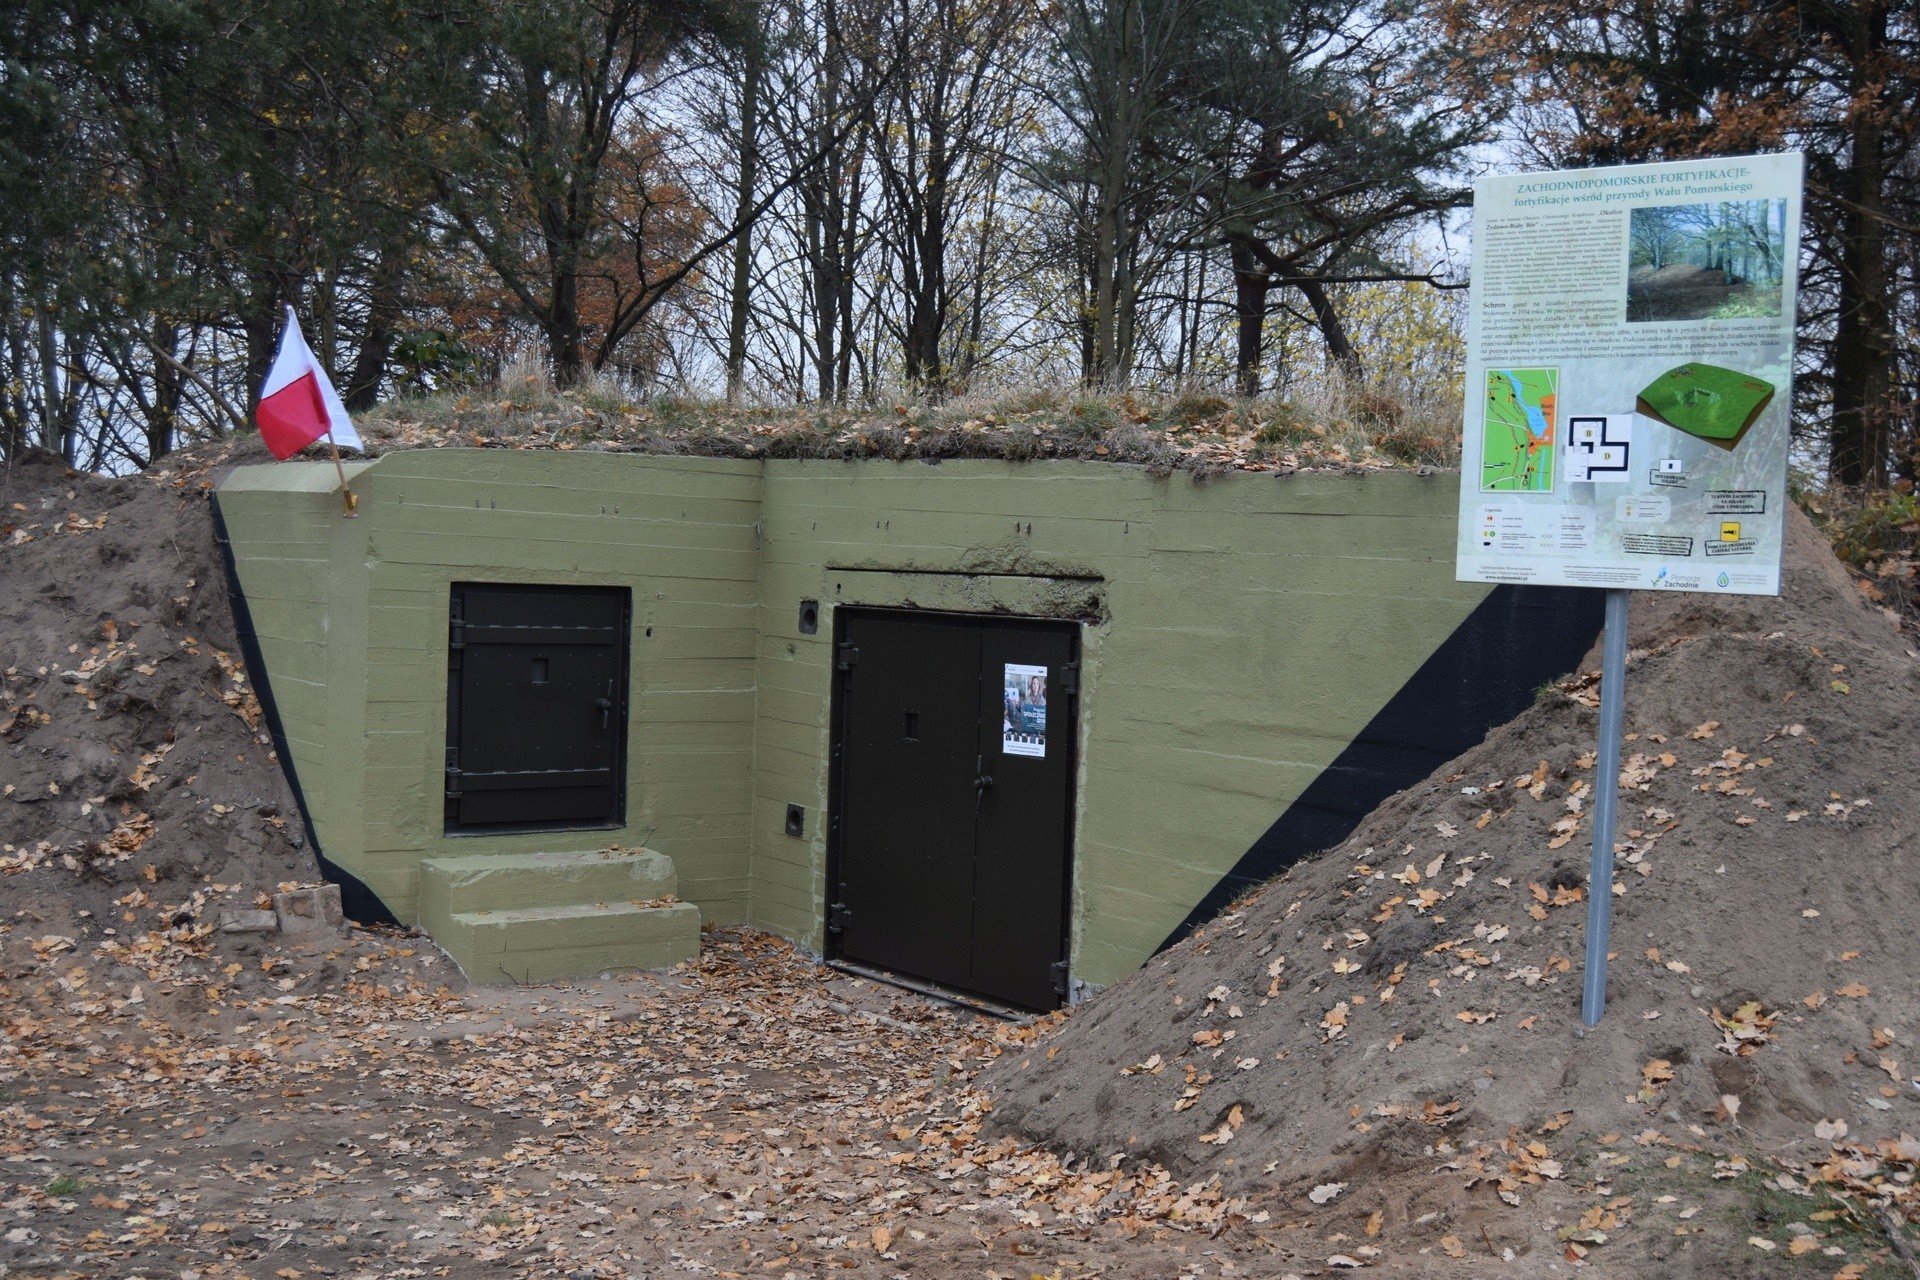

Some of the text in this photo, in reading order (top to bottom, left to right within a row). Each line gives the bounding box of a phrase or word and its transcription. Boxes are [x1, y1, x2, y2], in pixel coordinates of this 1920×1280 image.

[1514, 181, 1753, 208] fortyfikacje wśród przyrody Wału Pomorskiego
[1518, 175, 1657, 194] ZACHODNIOPOMORSKIE
